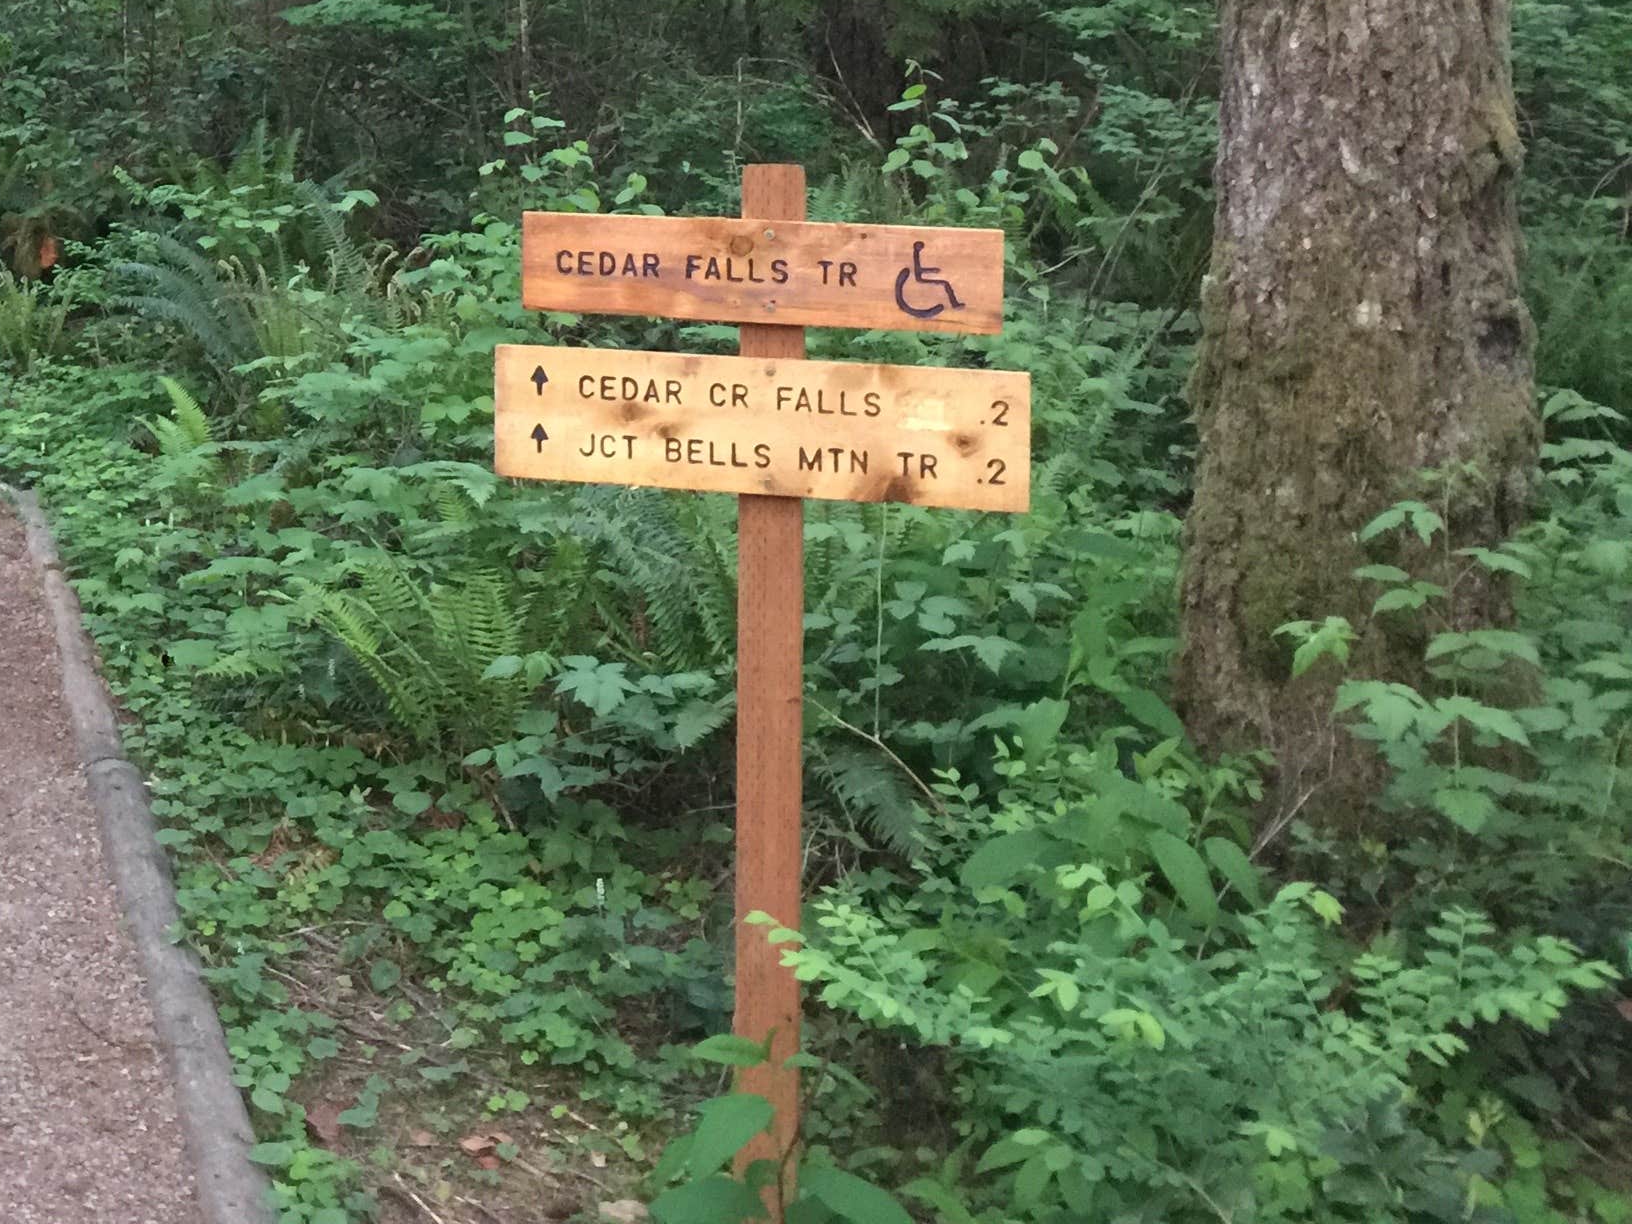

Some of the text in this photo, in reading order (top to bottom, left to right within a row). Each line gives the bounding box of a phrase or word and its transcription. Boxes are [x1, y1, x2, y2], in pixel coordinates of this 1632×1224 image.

[556, 250, 858, 287] CEDAR FALLS TR
[578, 375, 1010, 426] CEDAR CR FALLS .2
[579, 433, 1007, 486] JCT BELLS MTN TR .2
